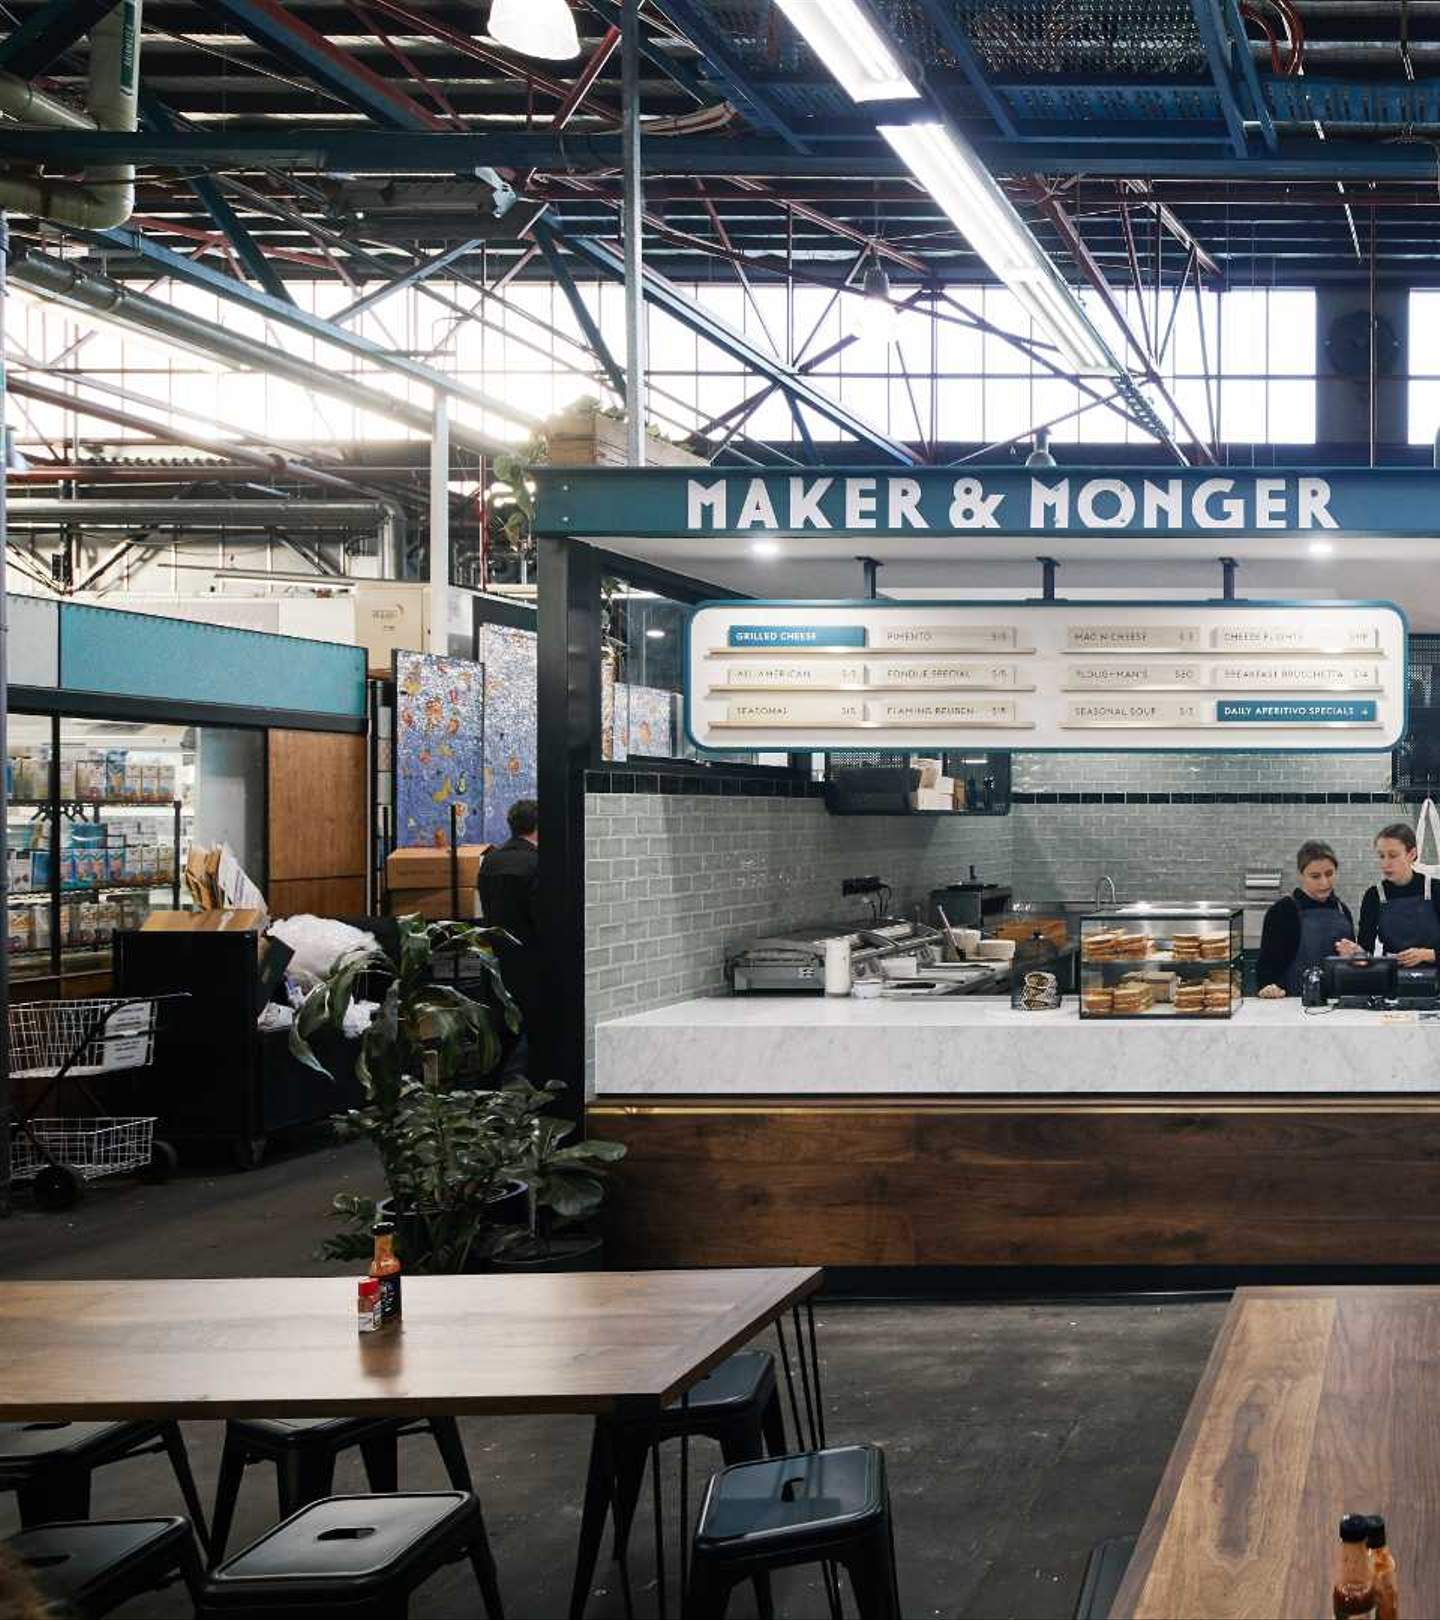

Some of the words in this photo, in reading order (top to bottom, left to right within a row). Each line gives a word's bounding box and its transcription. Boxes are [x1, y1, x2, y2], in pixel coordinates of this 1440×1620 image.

[687, 478, 930, 529] MAKER
[949, 477, 1006, 529] &
[1030, 477, 1340, 529] MONGER
[735, 631, 777, 641] GRILLED
[780, 631, 817, 641] CHEESE
[1224, 706, 1252, 715] DAILY
[1255, 706, 1306, 715] APERITIVO
[1308, 706, 1354, 715] SPECIALS
